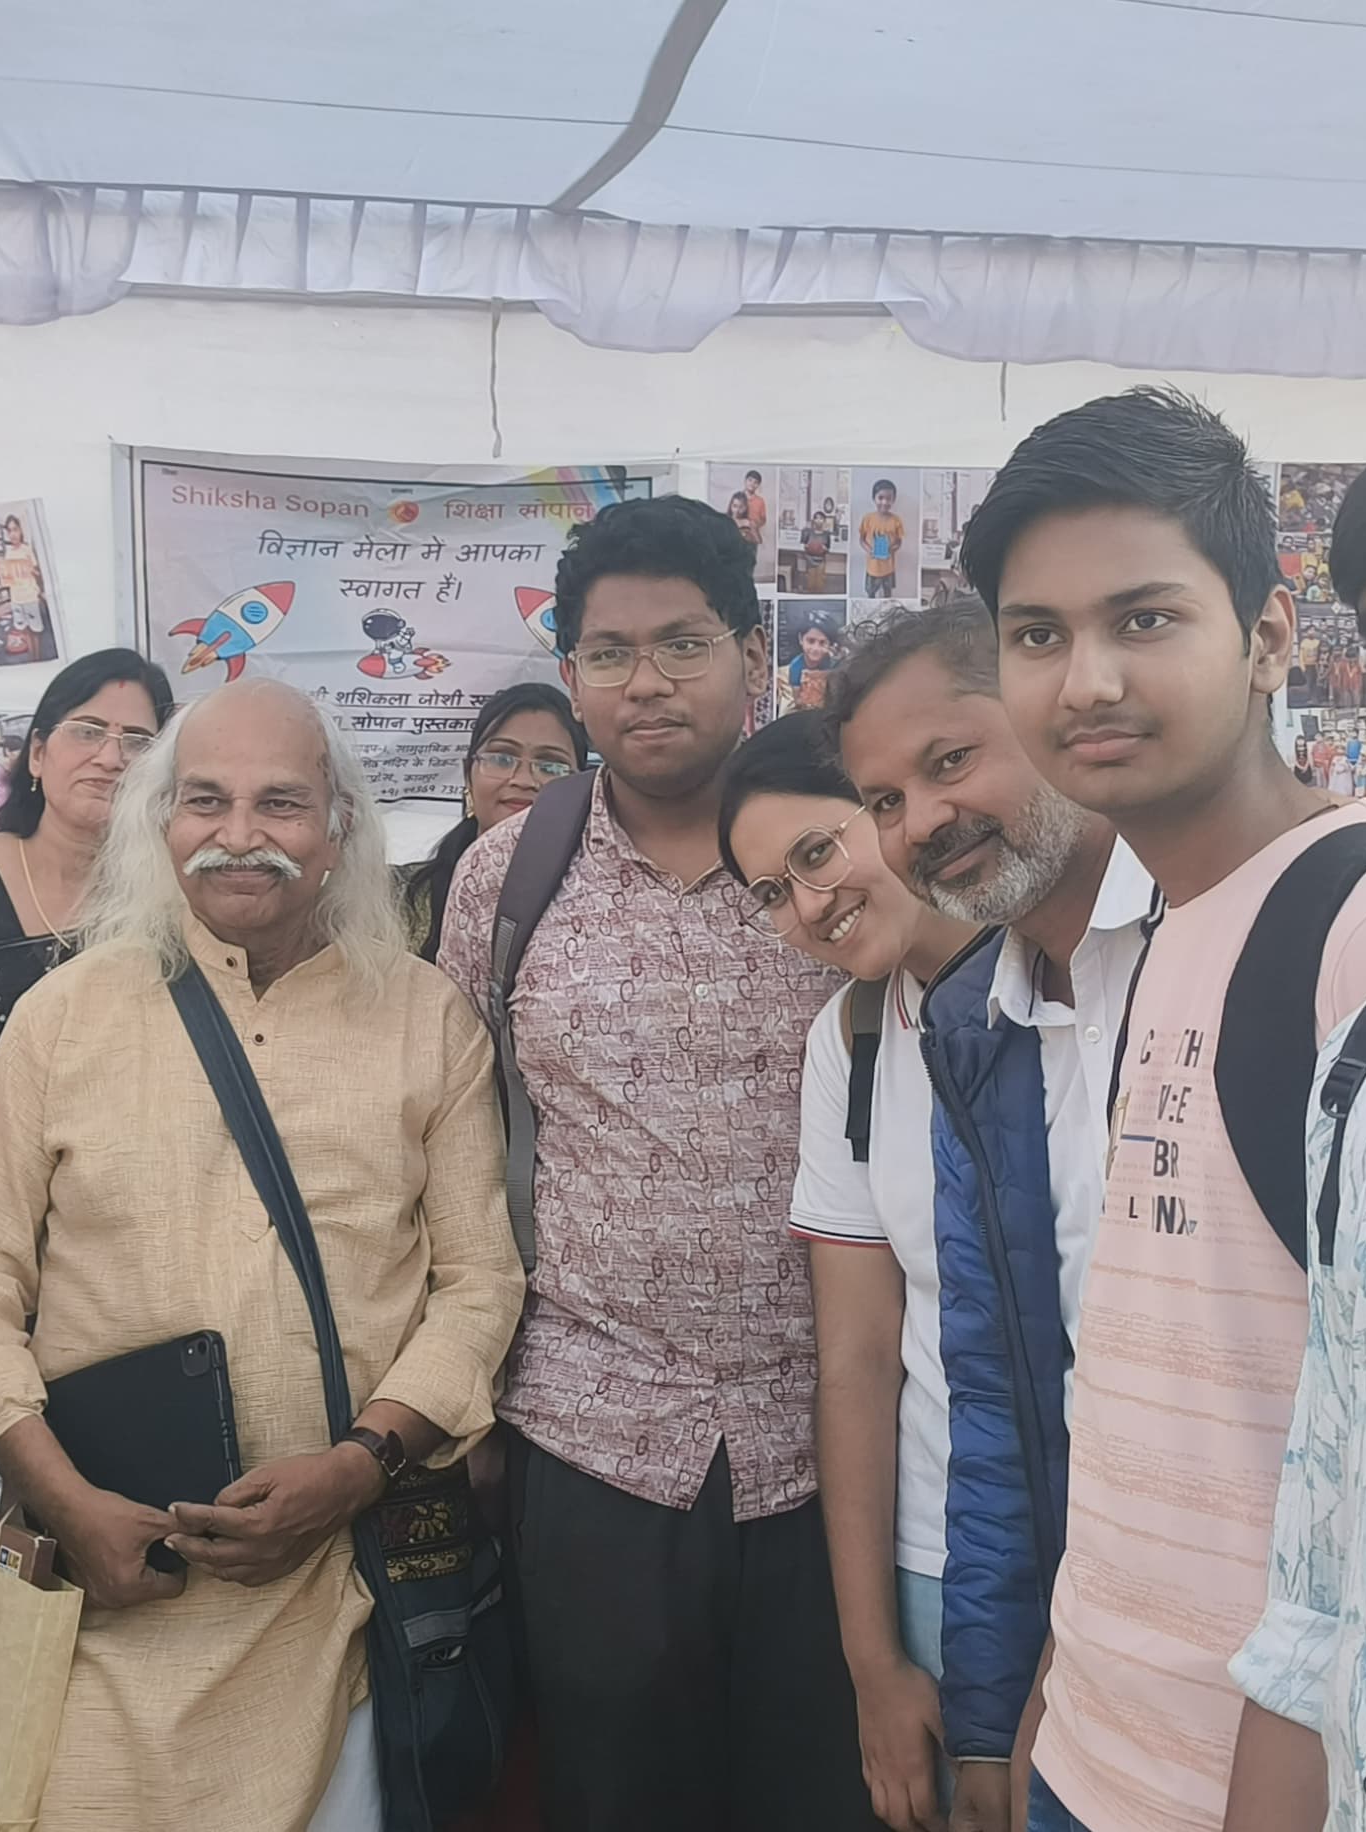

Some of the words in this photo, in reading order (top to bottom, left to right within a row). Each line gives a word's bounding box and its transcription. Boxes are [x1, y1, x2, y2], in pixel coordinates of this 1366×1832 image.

[171, 485, 276, 511] Shiksha
[285, 494, 370, 518] Sopan
[444, 499, 504, 522] शिक्षा
[518, 499, 595, 523] सोपान
[257, 529, 344, 561] विज्ञान
[351, 535, 412, 562] मेला
[420, 536, 447, 562] में
[455, 543, 547, 563] आपका
[339, 578, 427, 601] स्वागत
[335, 687, 412, 706] शशिकला
[418, 688, 465, 706] जोशी
[351, 712, 407, 729] सोपान
